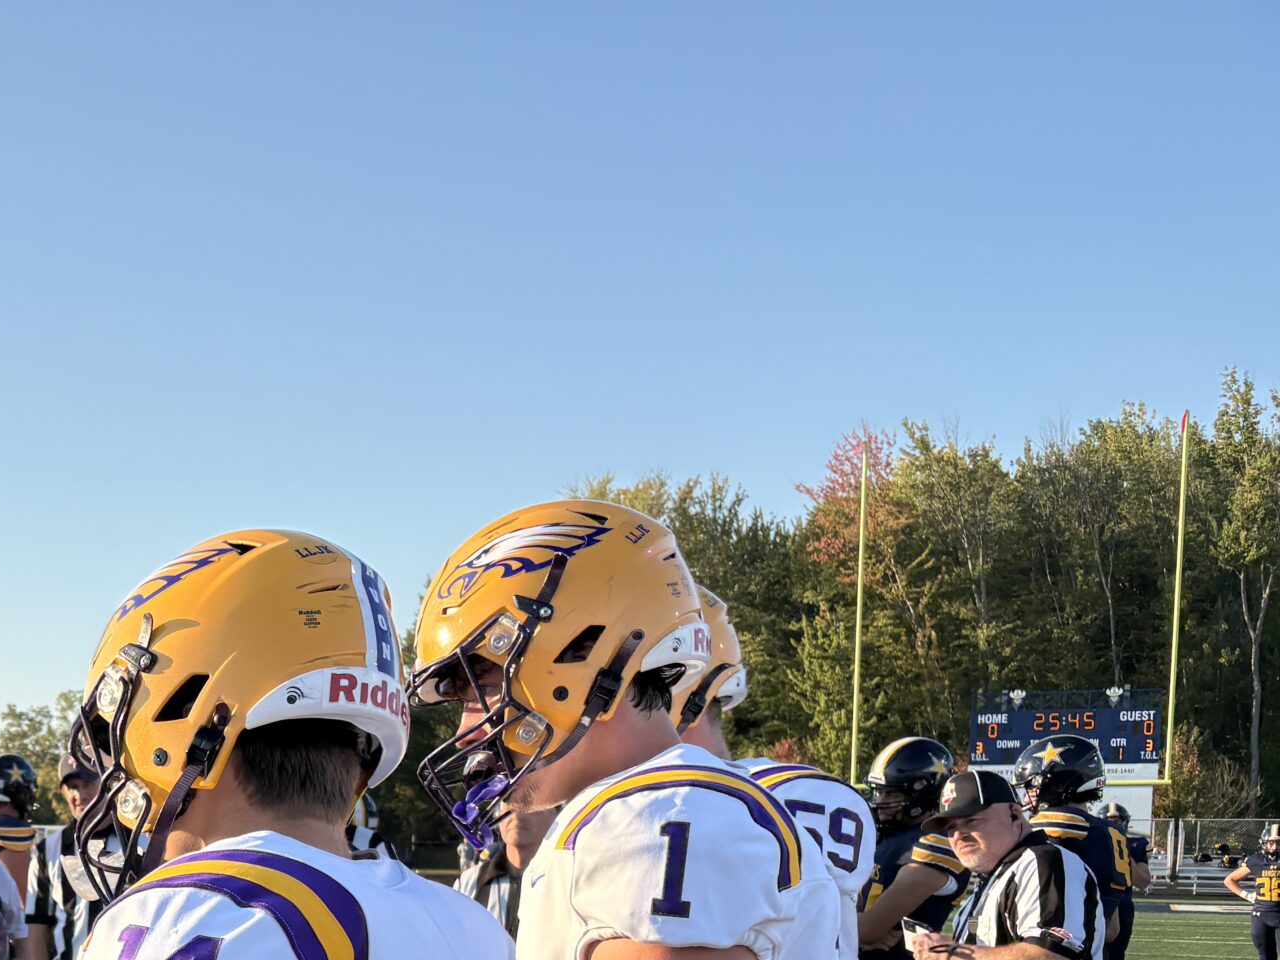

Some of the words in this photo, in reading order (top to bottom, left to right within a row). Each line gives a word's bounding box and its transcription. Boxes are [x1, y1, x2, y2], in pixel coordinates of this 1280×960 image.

[329, 673, 409, 730] Ridde
[977, 713, 1008, 725] HOME
[1033, 711, 1096, 732] 25:45
[1119, 710, 1156, 722] GUEST
[987, 723, 998, 739] 0
[1143, 720, 1154, 737] 0
[975, 741, 984, 754] 3
[996, 739, 1020, 749] DOWN
[1110, 738, 1127, 747] QTR
[1145, 739, 1154, 752] 3
[784, 799, 864, 874] 59
[650, 820, 691, 919] 1
